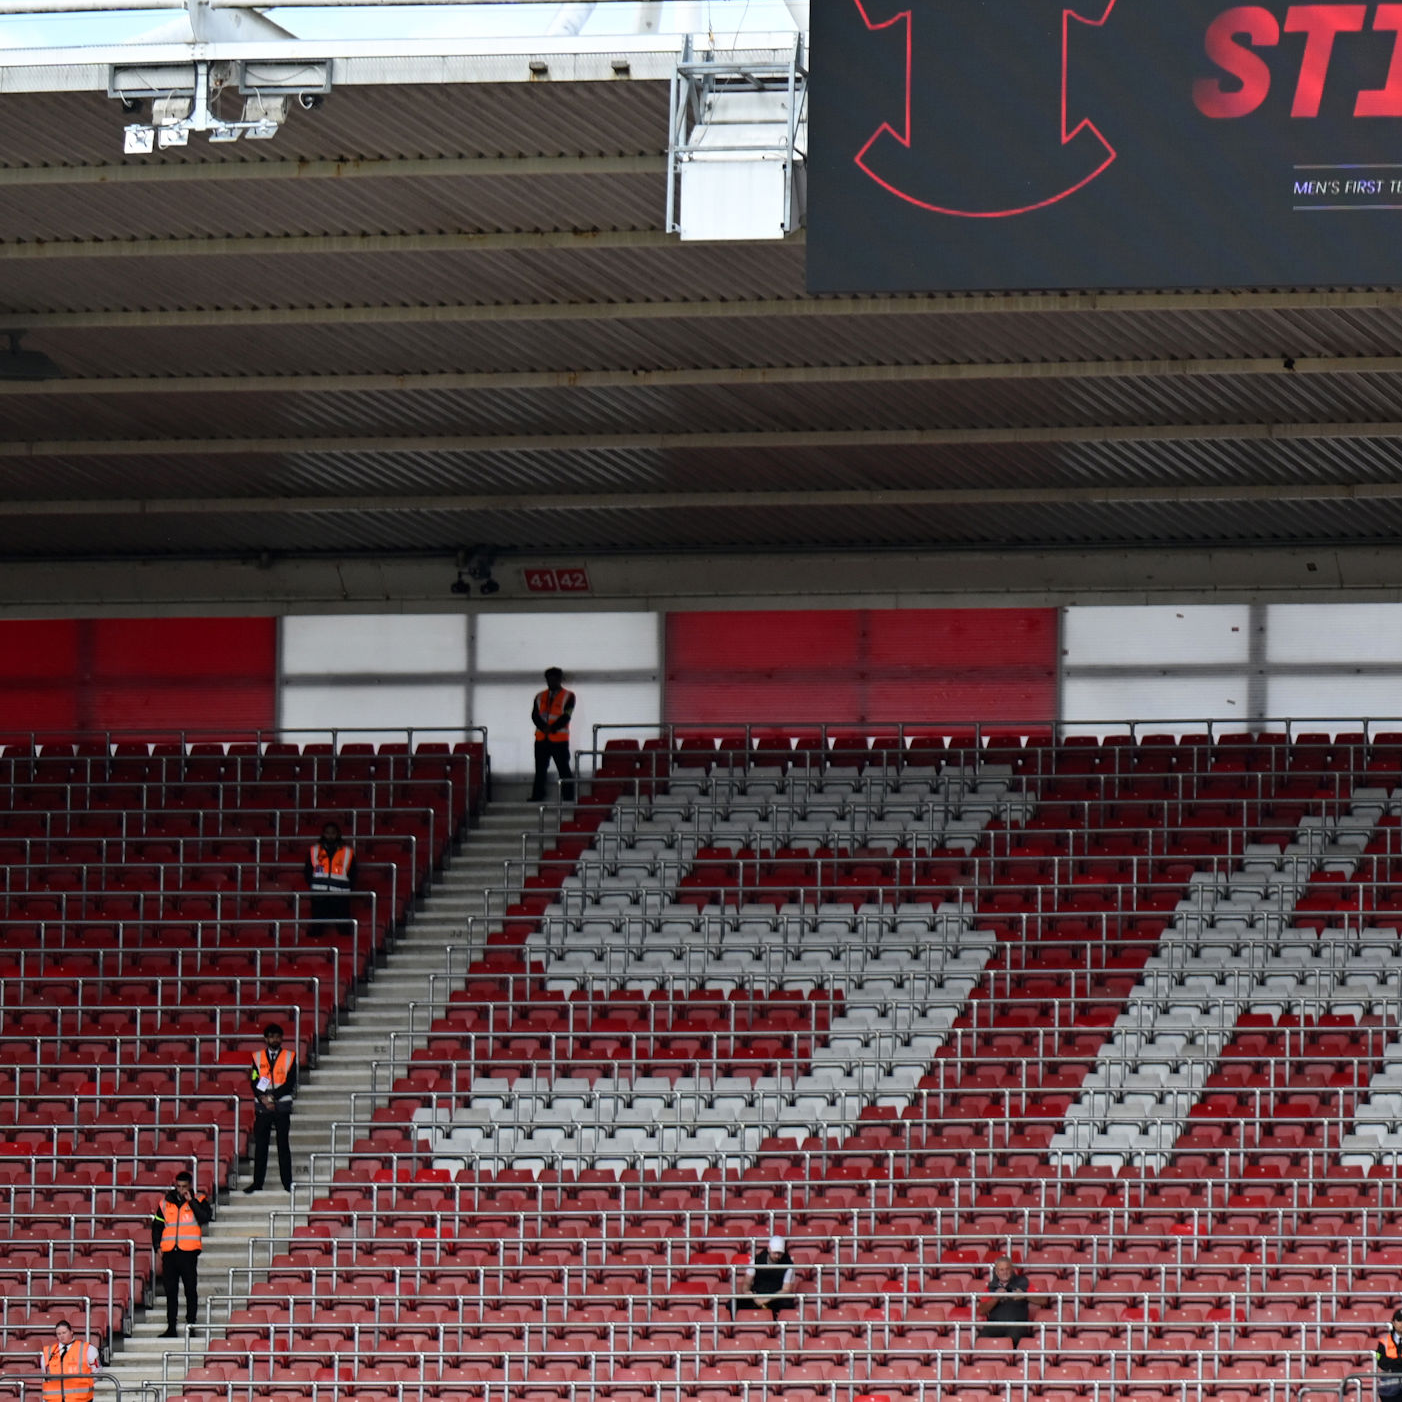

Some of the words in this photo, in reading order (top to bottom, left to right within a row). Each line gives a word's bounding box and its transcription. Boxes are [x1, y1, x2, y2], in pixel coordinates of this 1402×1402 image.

[1293, 180, 1341, 196] MEN'S
[1344, 179, 1383, 195] FIRST
[530, 573, 553, 588] 41
[560, 572, 586, 587] 42
